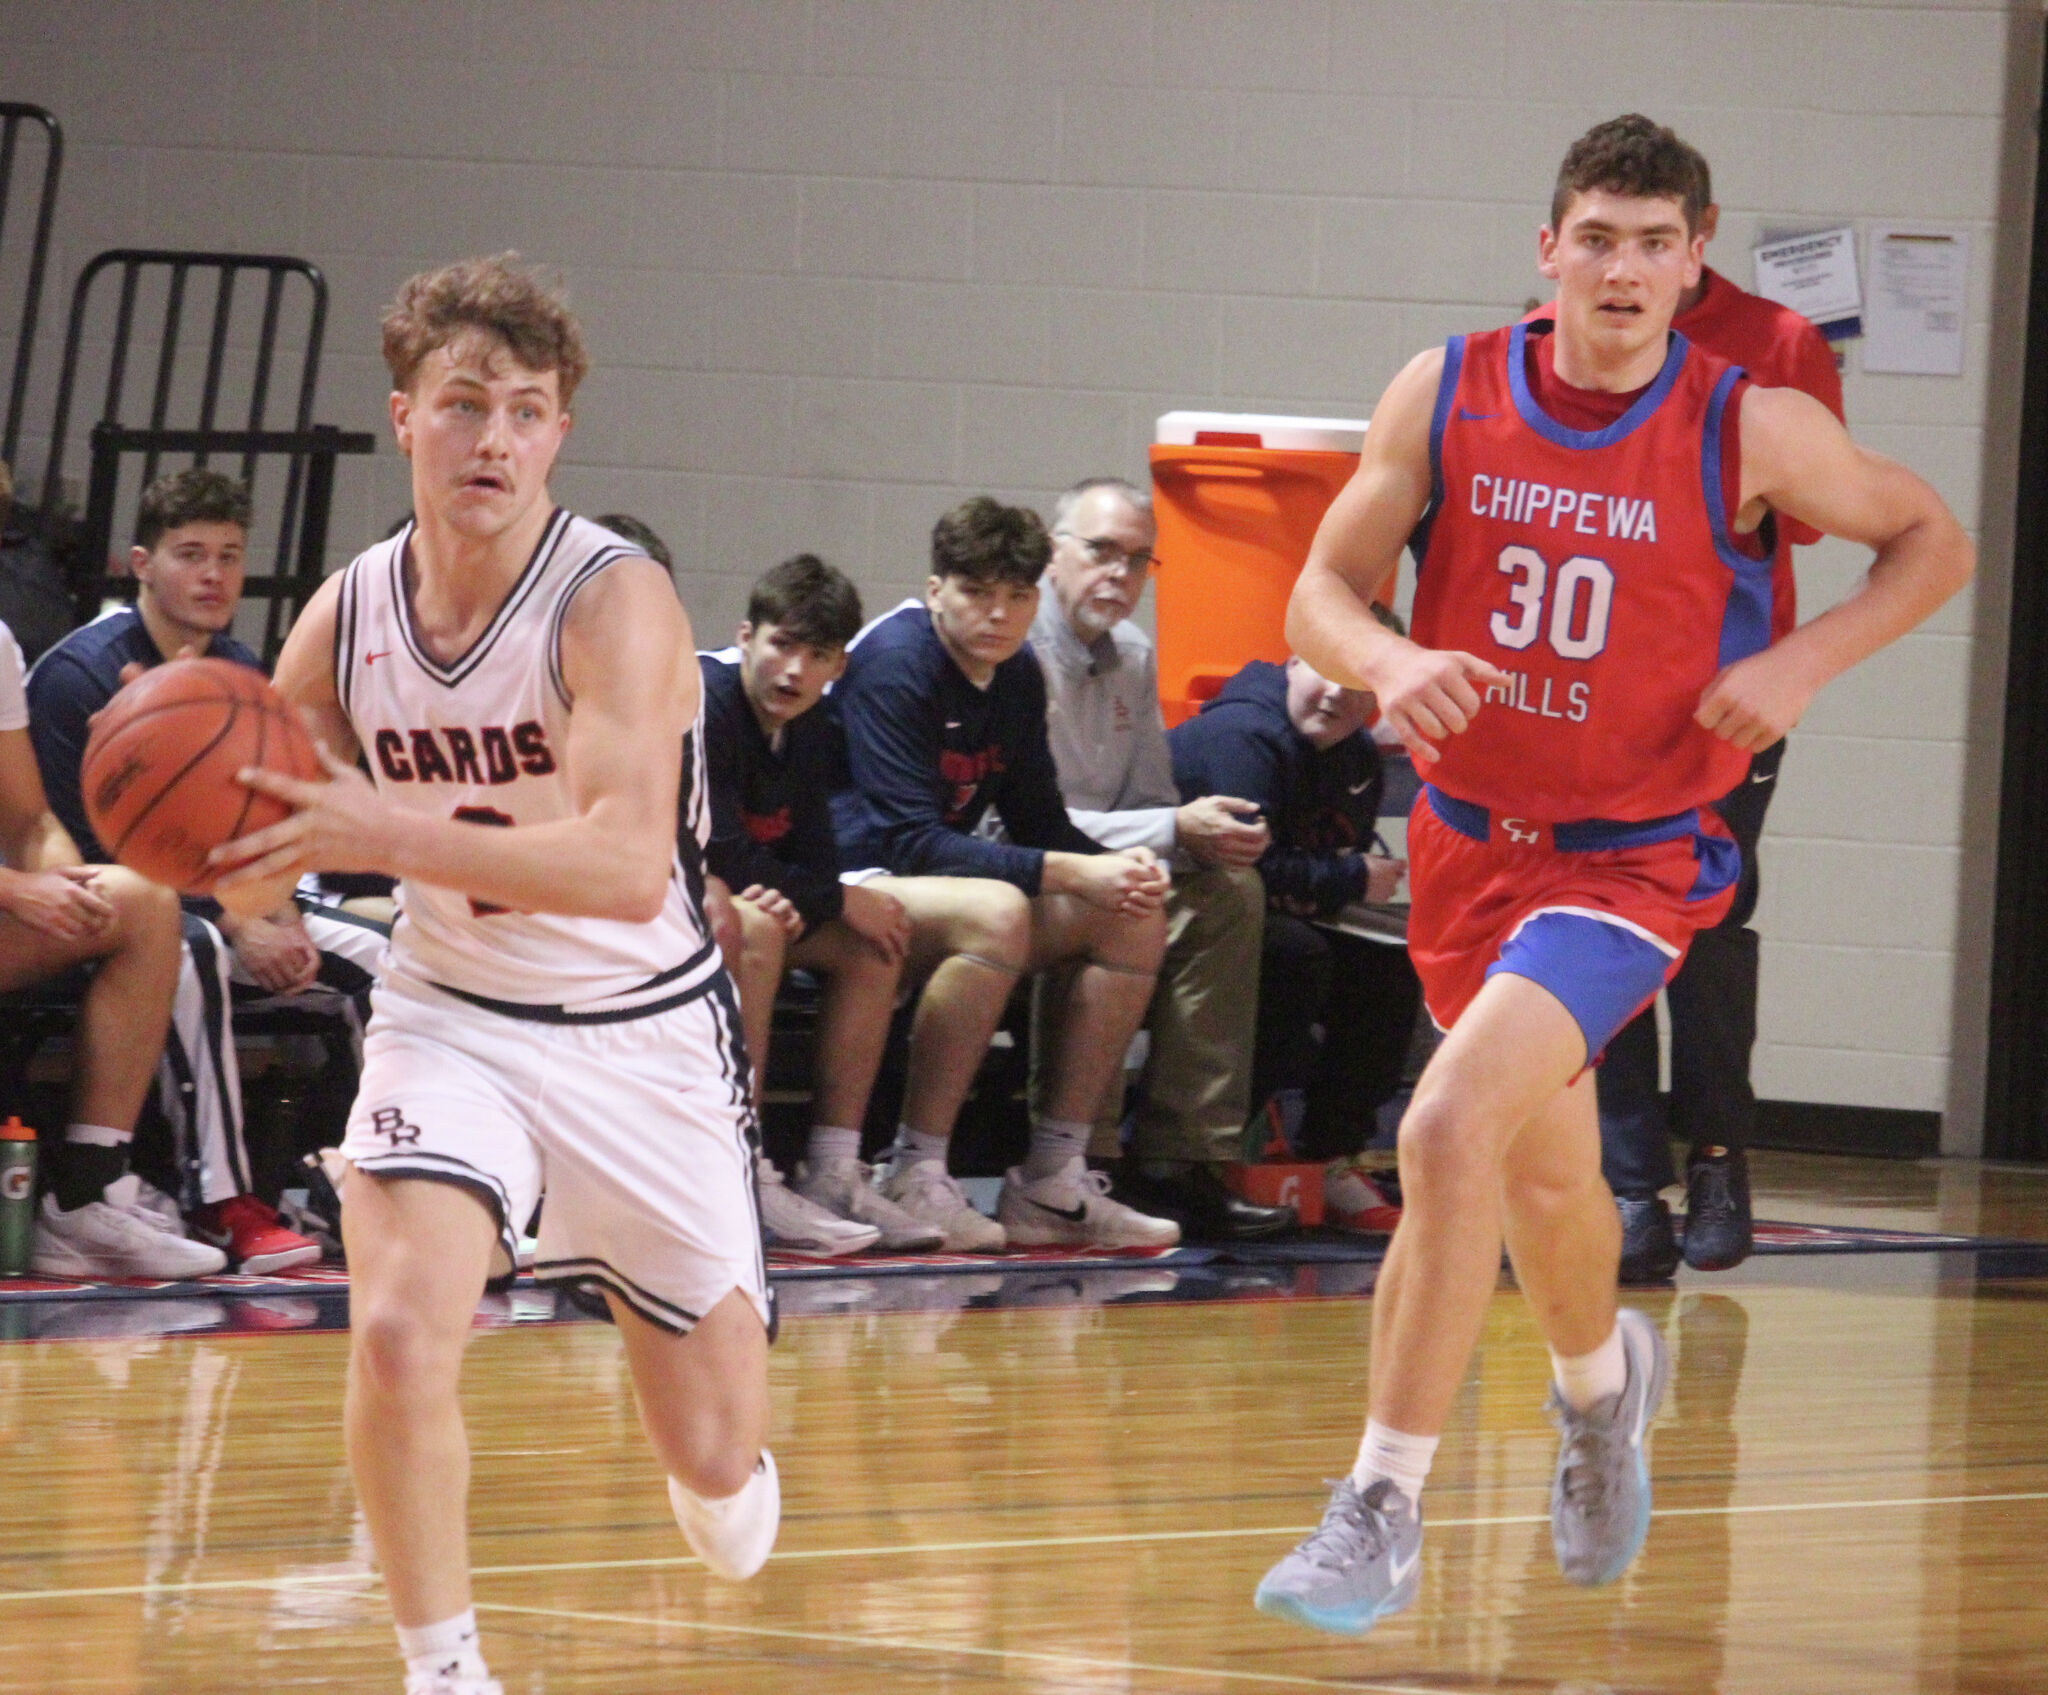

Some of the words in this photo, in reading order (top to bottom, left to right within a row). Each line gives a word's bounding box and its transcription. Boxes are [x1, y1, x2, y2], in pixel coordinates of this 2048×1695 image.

[1470, 473, 1657, 542] CHIPPEWA
[1489, 543, 1616, 660] 30
[375, 720, 557, 785] CARDS
[2, 1166, 31, 1200] G
